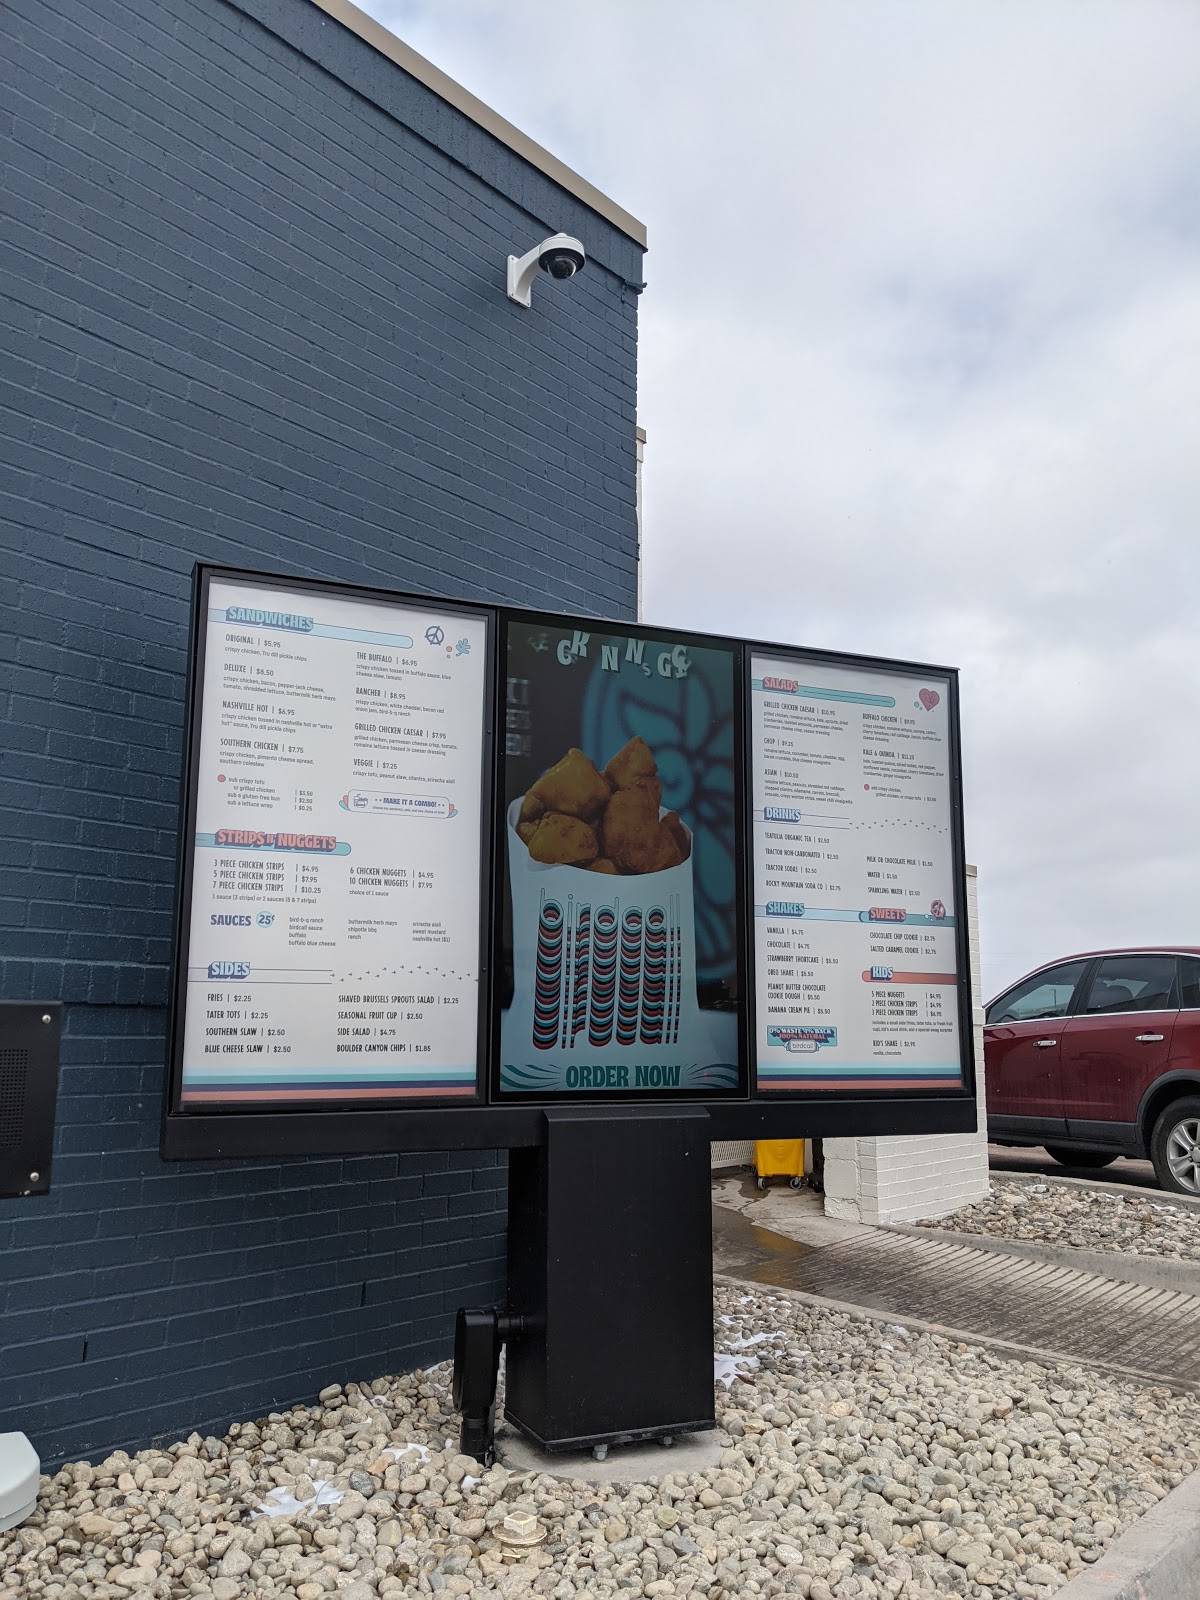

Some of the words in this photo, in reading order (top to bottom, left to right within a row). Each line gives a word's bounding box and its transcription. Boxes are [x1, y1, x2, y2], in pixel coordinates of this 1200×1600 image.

[226, 606, 314, 632] SANDWICHES
[226, 634, 254, 644] ORIGINAL
[264, 640, 280, 648] $5.95
[357, 652, 366, 660] THE
[369, 653, 392, 663] BUFFALO
[224, 663, 246, 673] DELUXE
[763, 677, 798, 693] SALADS
[356, 688, 380, 697] RANCHER
[222, 700, 254, 711] NASHVILLE
[257, 704, 268, 712] HOT
[278, 708, 295, 716] $6.95
[781, 703, 798, 711] CHICKEN
[800, 705, 815, 713] CAESAR
[355, 723, 376, 732] GRILLED
[379, 725, 402, 734] CHICKEN
[403, 728, 423, 737] CAESAR
[220, 738, 252, 749] SOUTHERN
[254, 741, 278, 751] CHICKEN
[288, 745, 304, 753] $7.75
[354, 759, 373, 768] VEGGIE
[382, 762, 398, 770] $7.25
[414, 800, 437, 808] COMBO!
[764, 807, 800, 823] DRINKS
[216, 829, 266, 846] STRIPS
[274, 832, 336, 852] NUGGETS
[220, 860, 236, 868] PIECE
[238, 861, 263, 870] CHICKEN
[266, 862, 284, 870] STRIPS
[220, 870, 236, 879] PIECE
[238, 872, 263, 880] CHICKEN
[266, 873, 284, 881] STRIPS
[357, 867, 380, 875] CHICKEN
[382, 868, 406, 877] NUGGETS
[219, 881, 235, 889] PIECE
[238, 882, 262, 891] CHICKEN
[265, 884, 284, 892] STRIPS
[301, 886, 321, 894] $10.25
[358, 878, 382, 886] CHICKEN
[384, 879, 408, 888] NUGGETS
[766, 901, 805, 916] SHAKES
[210, 914, 252, 926] SAUCES
[869, 907, 906, 922] SWEETS
[208, 961, 250, 979] SIDES
[532, 887, 682, 1050] birdcall
[870, 966, 893, 981] KIDS
[208, 993, 223, 1002] FRIES
[338, 995, 360, 1003] SHAVED
[363, 995, 389, 1003] BRUSSELS
[391, 996, 415, 1004] SPROUTS
[417, 996, 434, 1004] SALAD
[227, 1011, 240, 1019] TOTS
[338, 1012, 366, 1020] SEASONAL
[206, 1028, 237, 1036] SOUTHERN
[240, 1028, 257, 1036] SLAW
[267, 1029, 285, 1037] $2.50
[337, 1028, 349, 1036] SIDE
[352, 1028, 370, 1036] SALAD
[205, 1045, 220, 1053] BLUE
[223, 1045, 244, 1053] CHEESE
[246, 1045, 263, 1053] SLAW
[337, 1044, 362, 1052] BOULDER
[365, 1044, 388, 1052] CANYON
[391, 1044, 406, 1052] CHIPS
[566, 1065, 629, 1088] ORDER
[635, 1065, 681, 1087] NOW
